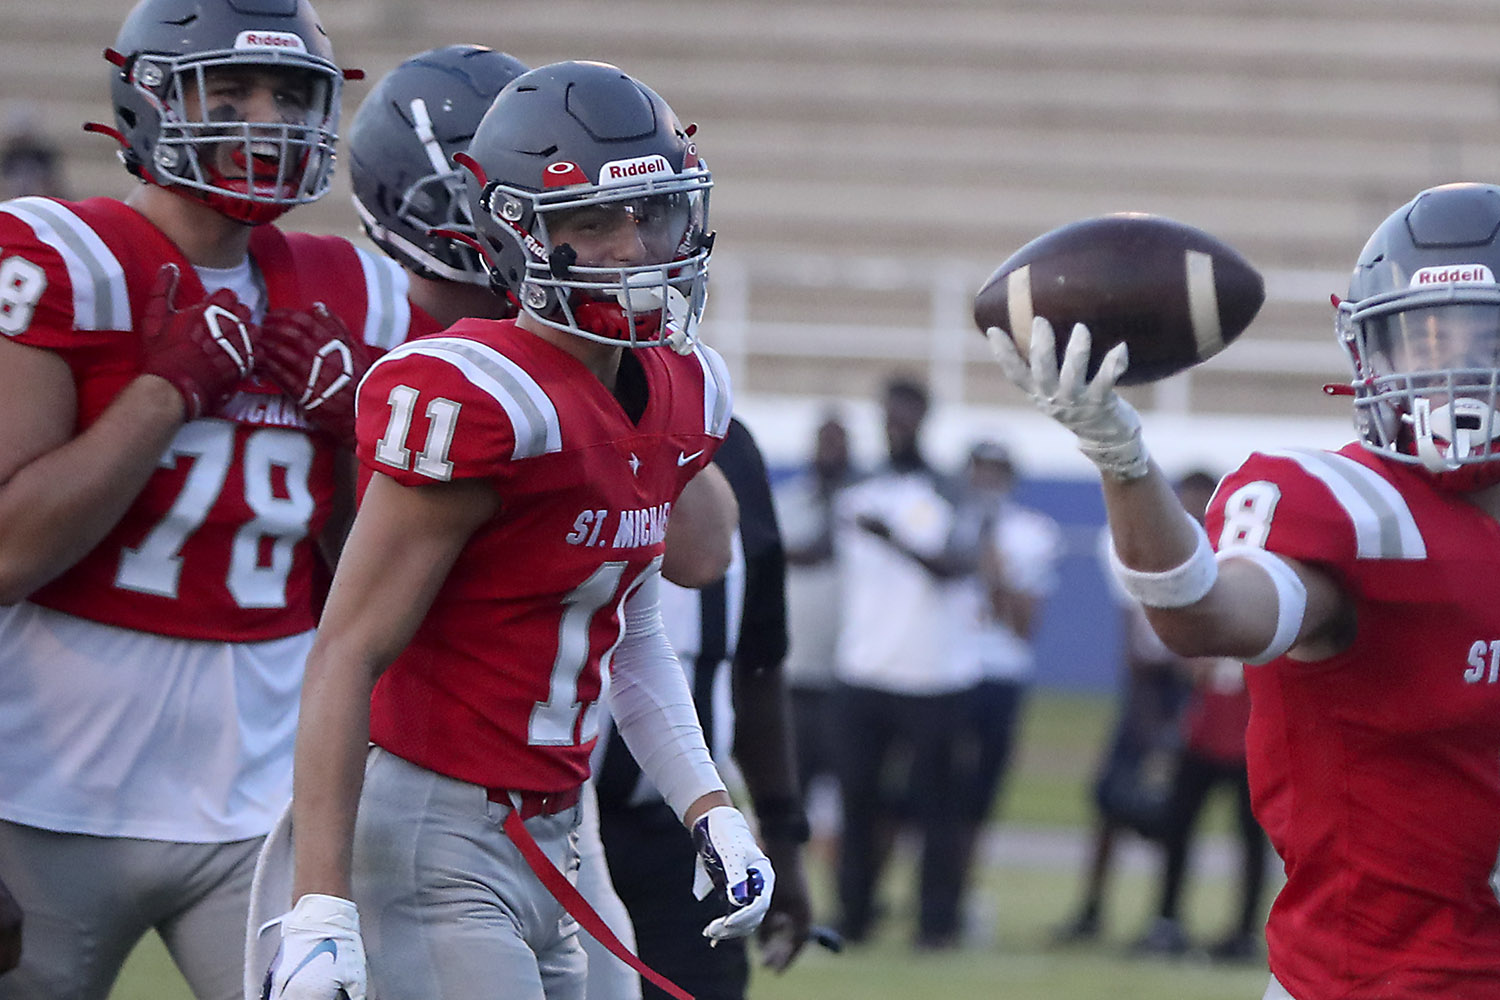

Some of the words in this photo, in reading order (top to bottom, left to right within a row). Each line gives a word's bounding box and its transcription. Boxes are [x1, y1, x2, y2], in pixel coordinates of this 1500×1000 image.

[608, 158, 666, 180] Riddell
[1418, 267, 1485, 284] Riddell
[374, 384, 463, 482] 11
[114, 417, 316, 609] 78
[565, 509, 608, 547] ST.
[1217, 480, 1283, 551] 8
